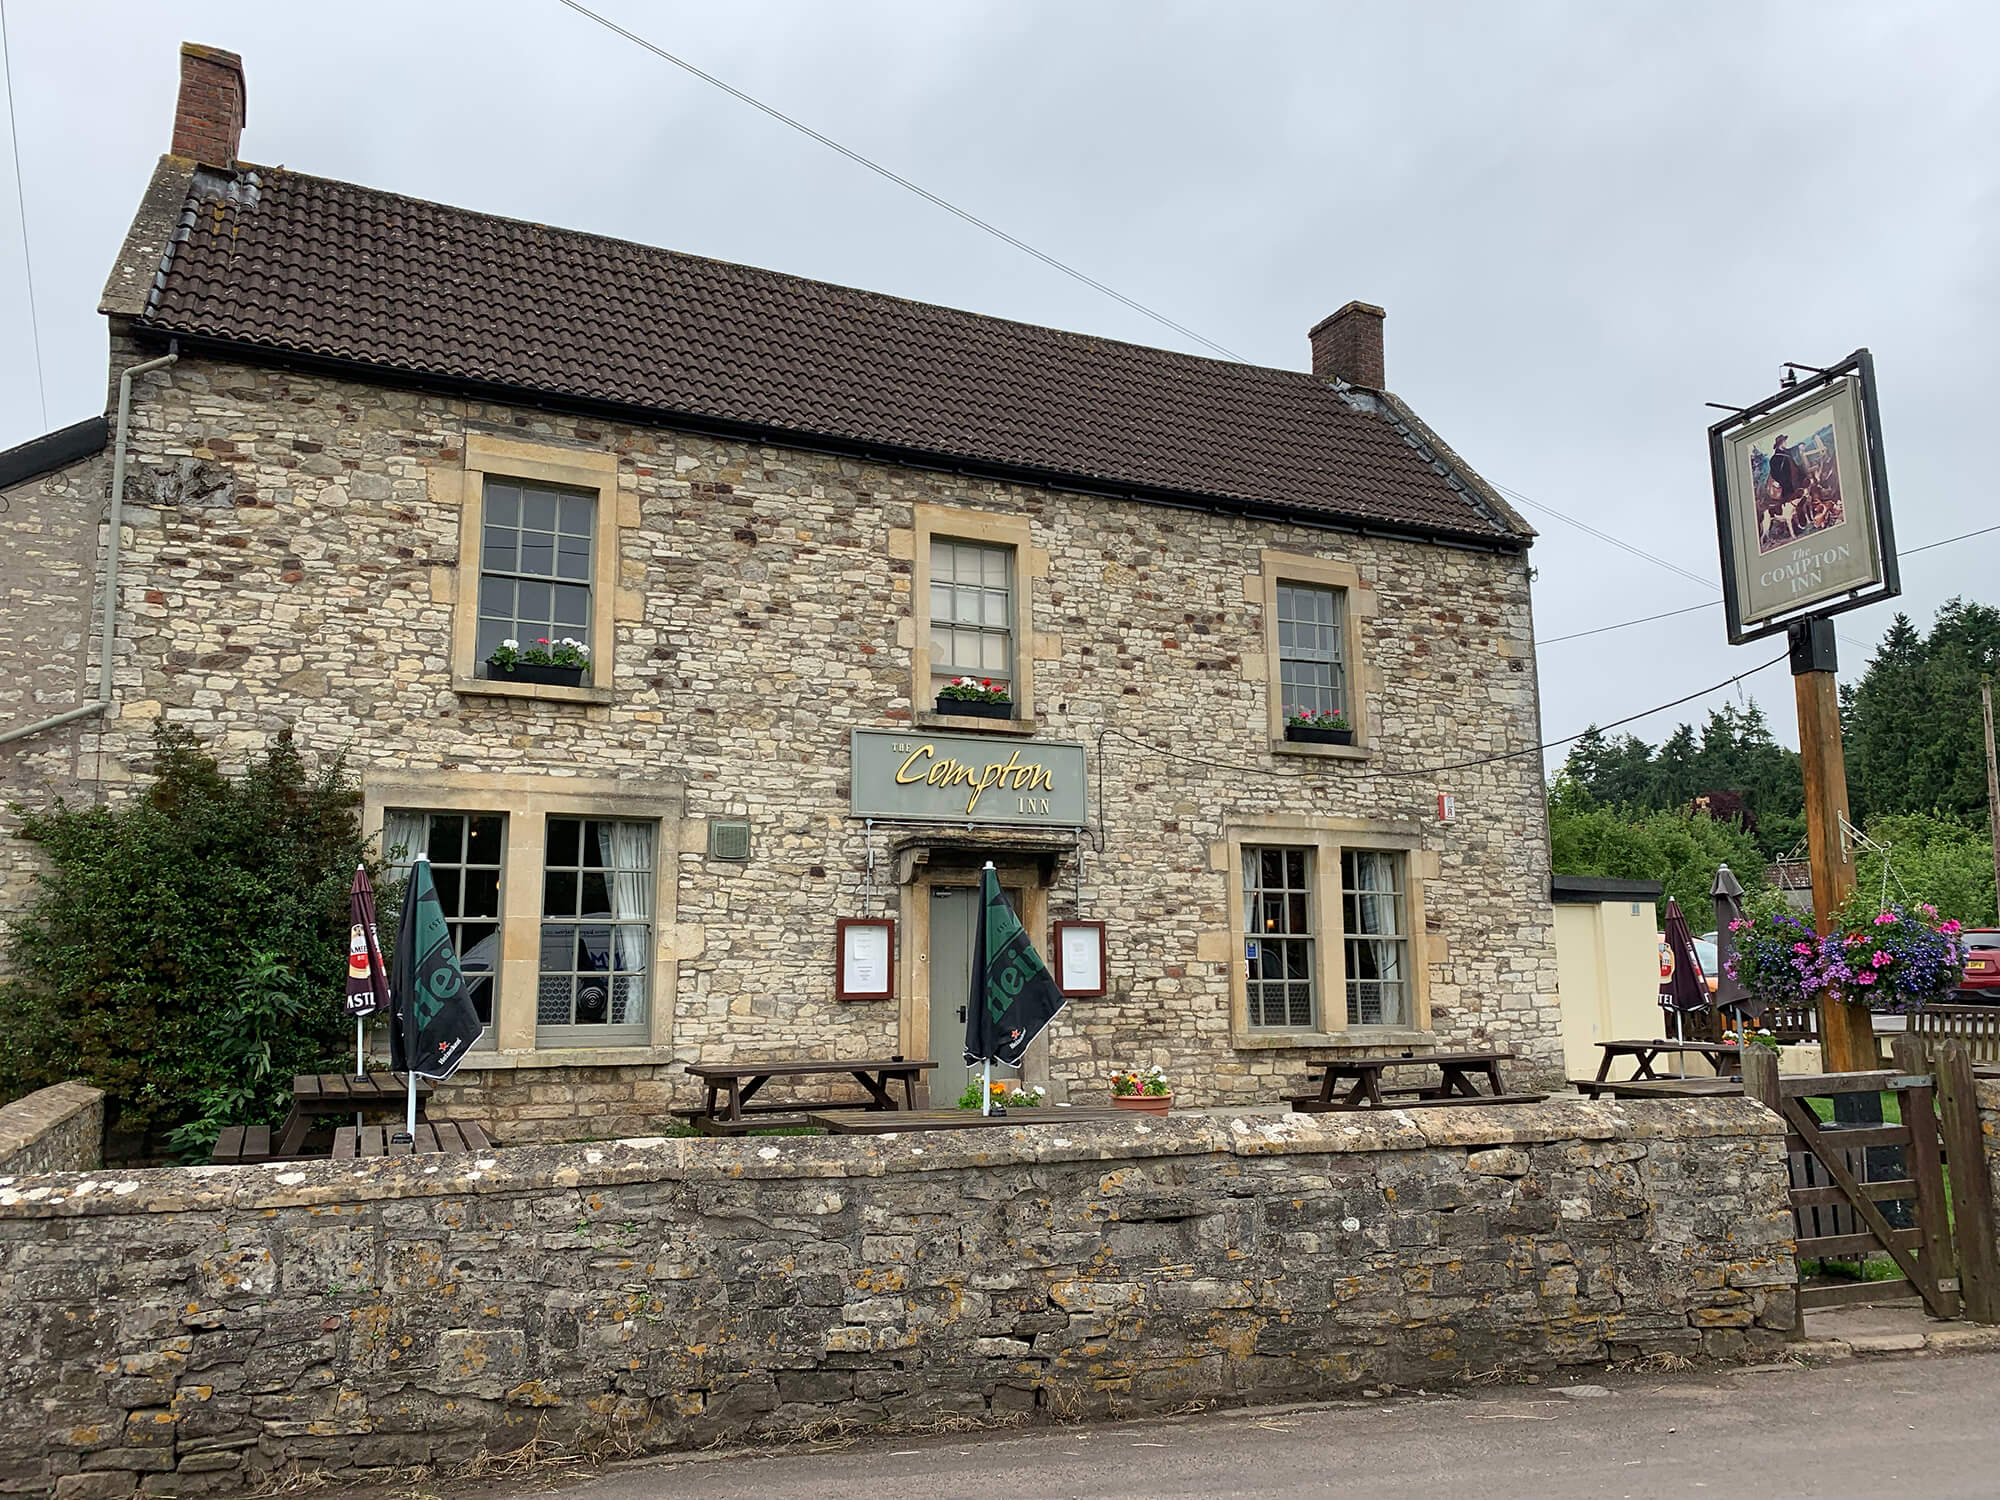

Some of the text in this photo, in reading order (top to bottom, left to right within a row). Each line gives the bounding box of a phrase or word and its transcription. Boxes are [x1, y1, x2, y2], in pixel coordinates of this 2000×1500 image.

[1760, 543, 1849, 586] COMPTON
[1791, 569, 1822, 593] INN
[892, 743, 911, 753] THE
[895, 744, 1054, 814] Compton
[1017, 797, 1050, 815] INN
